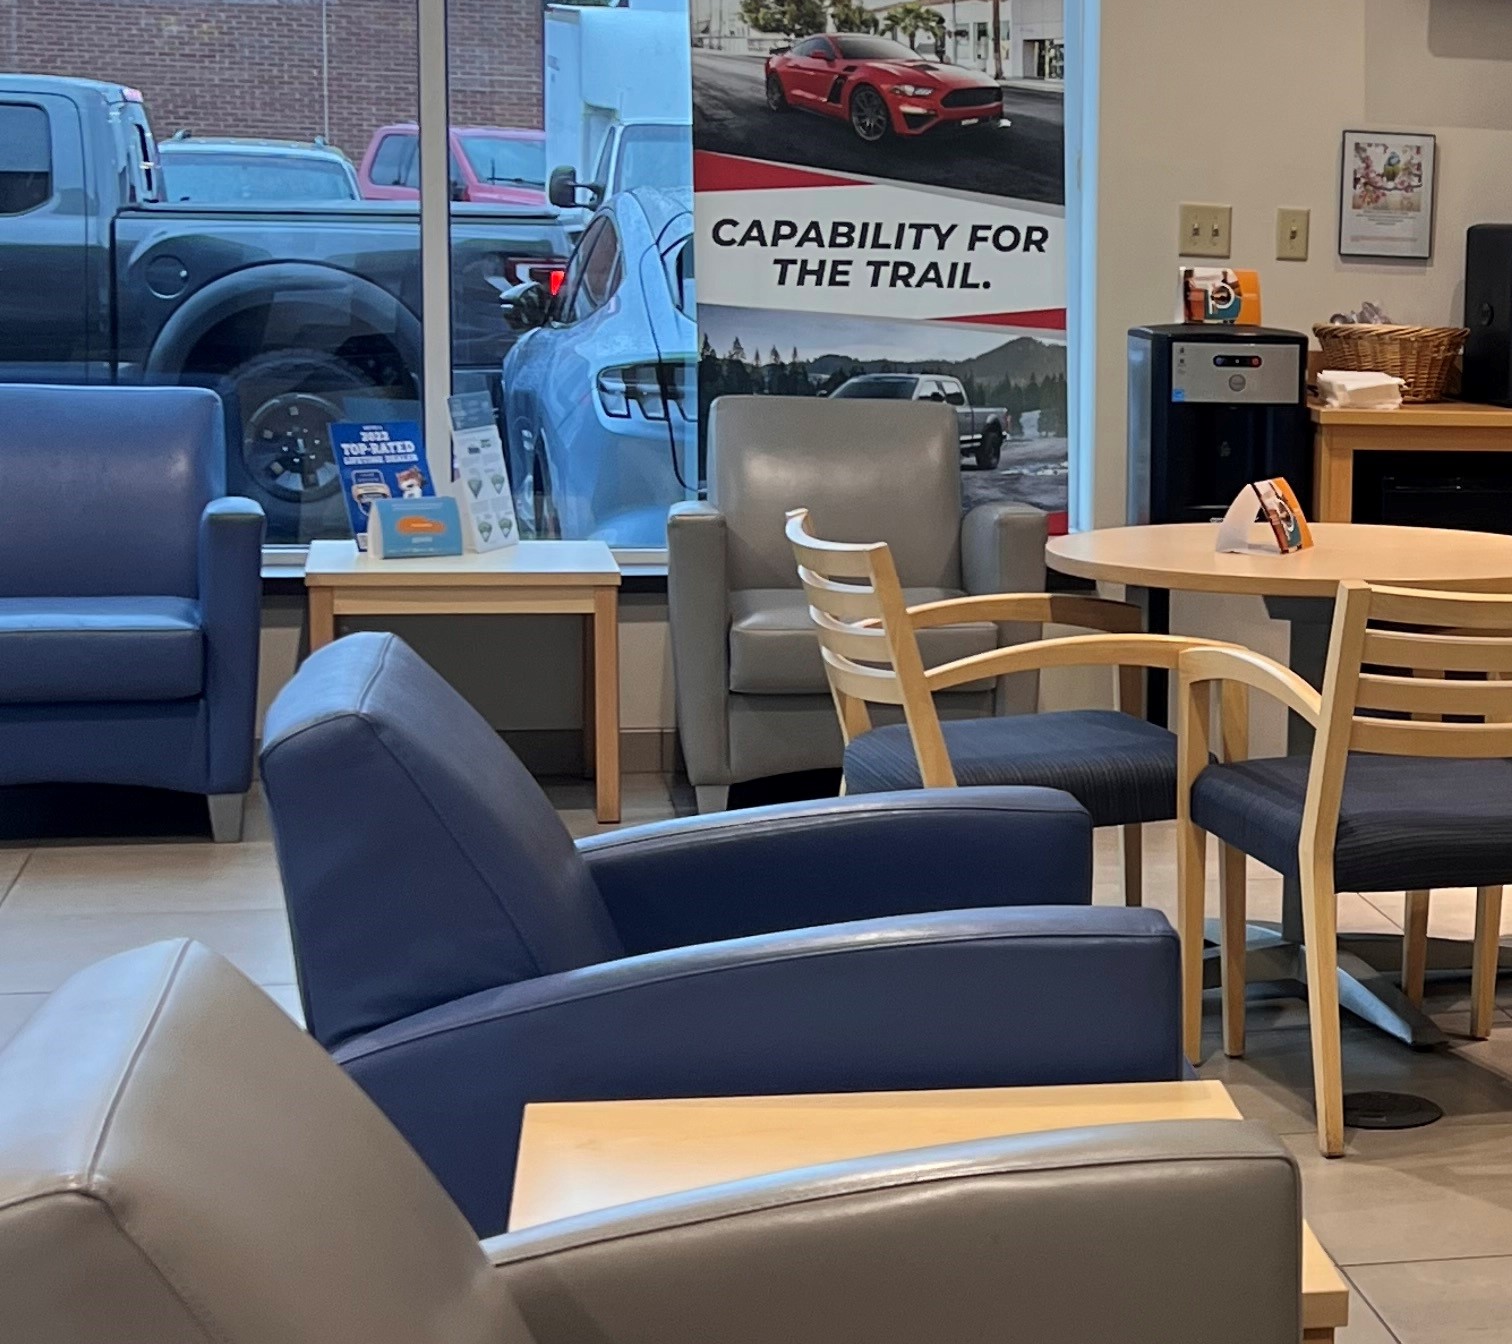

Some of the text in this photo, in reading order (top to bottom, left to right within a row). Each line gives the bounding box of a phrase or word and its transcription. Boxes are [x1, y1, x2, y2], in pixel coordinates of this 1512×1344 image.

[711, 218, 1050, 253] CAPABILITY FOR
[772, 258, 991, 290] THE TRAIL.
[340, 440, 416, 456] TOP-RATED
